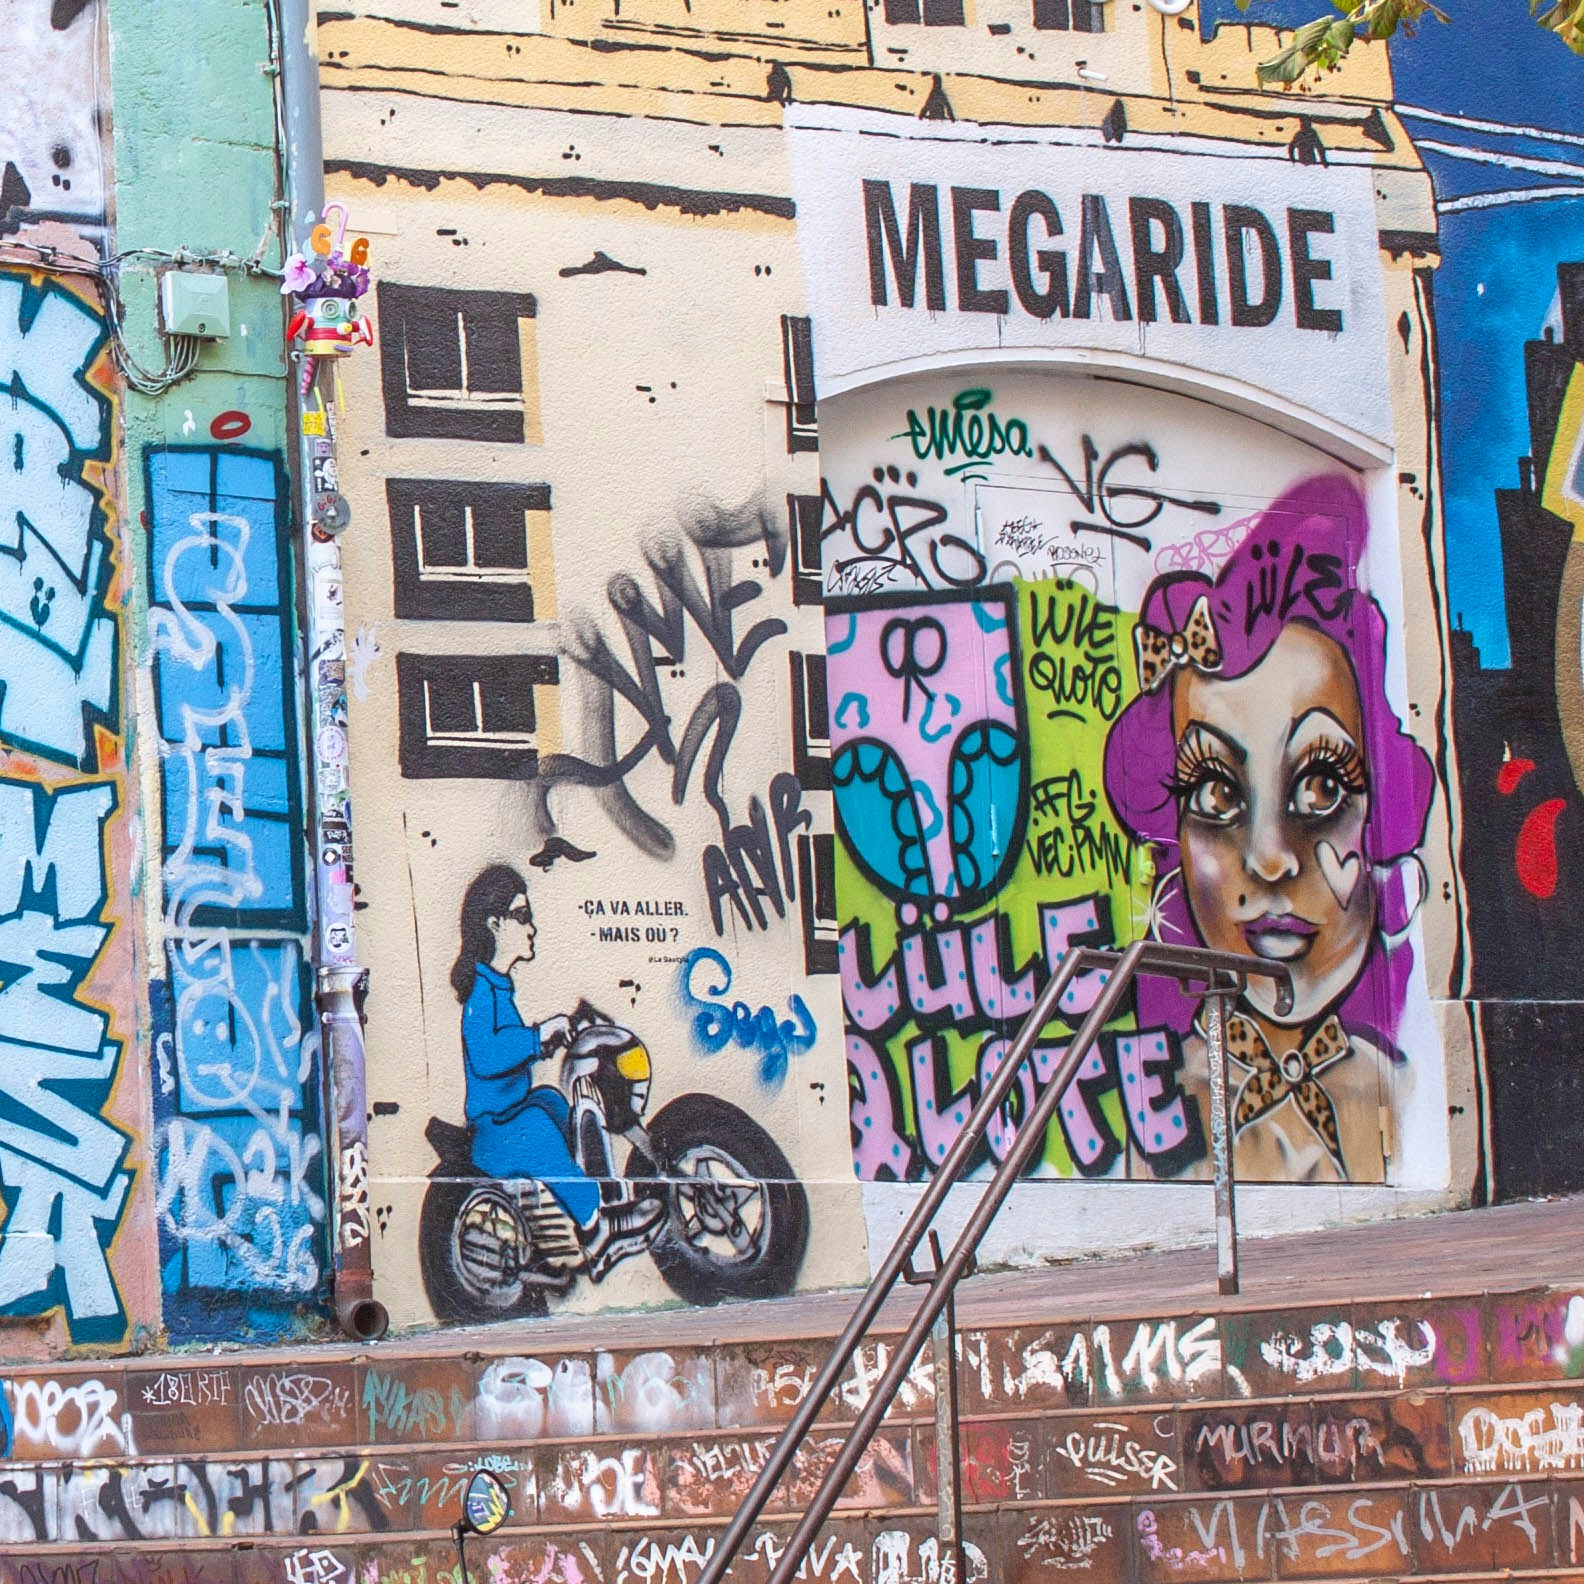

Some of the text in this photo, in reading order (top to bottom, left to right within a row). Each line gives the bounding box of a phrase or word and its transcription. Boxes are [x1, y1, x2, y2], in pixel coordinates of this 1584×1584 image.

[862, 179, 1344, 333] MEGARIDE
[610, 900, 630, 916] VA
[634, 900, 689, 917] ALLER.
